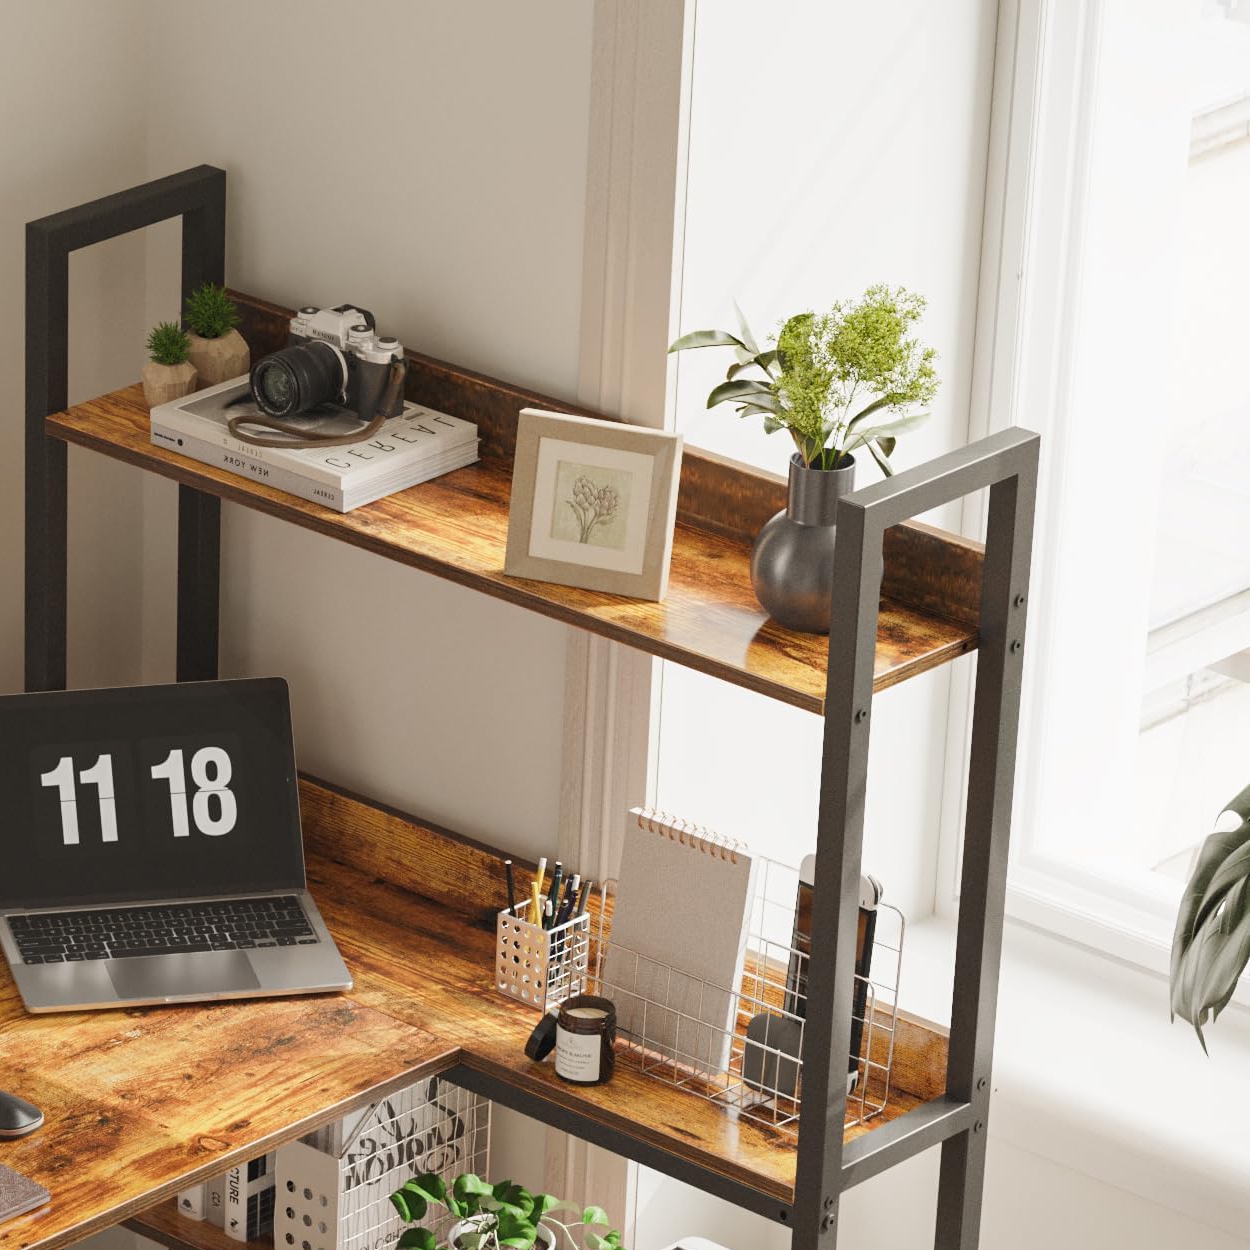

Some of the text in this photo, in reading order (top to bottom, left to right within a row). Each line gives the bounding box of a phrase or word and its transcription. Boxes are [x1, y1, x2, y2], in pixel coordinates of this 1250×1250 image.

[40, 746, 238, 845] 11 18
[212, 1191, 221, 1207] CCA
